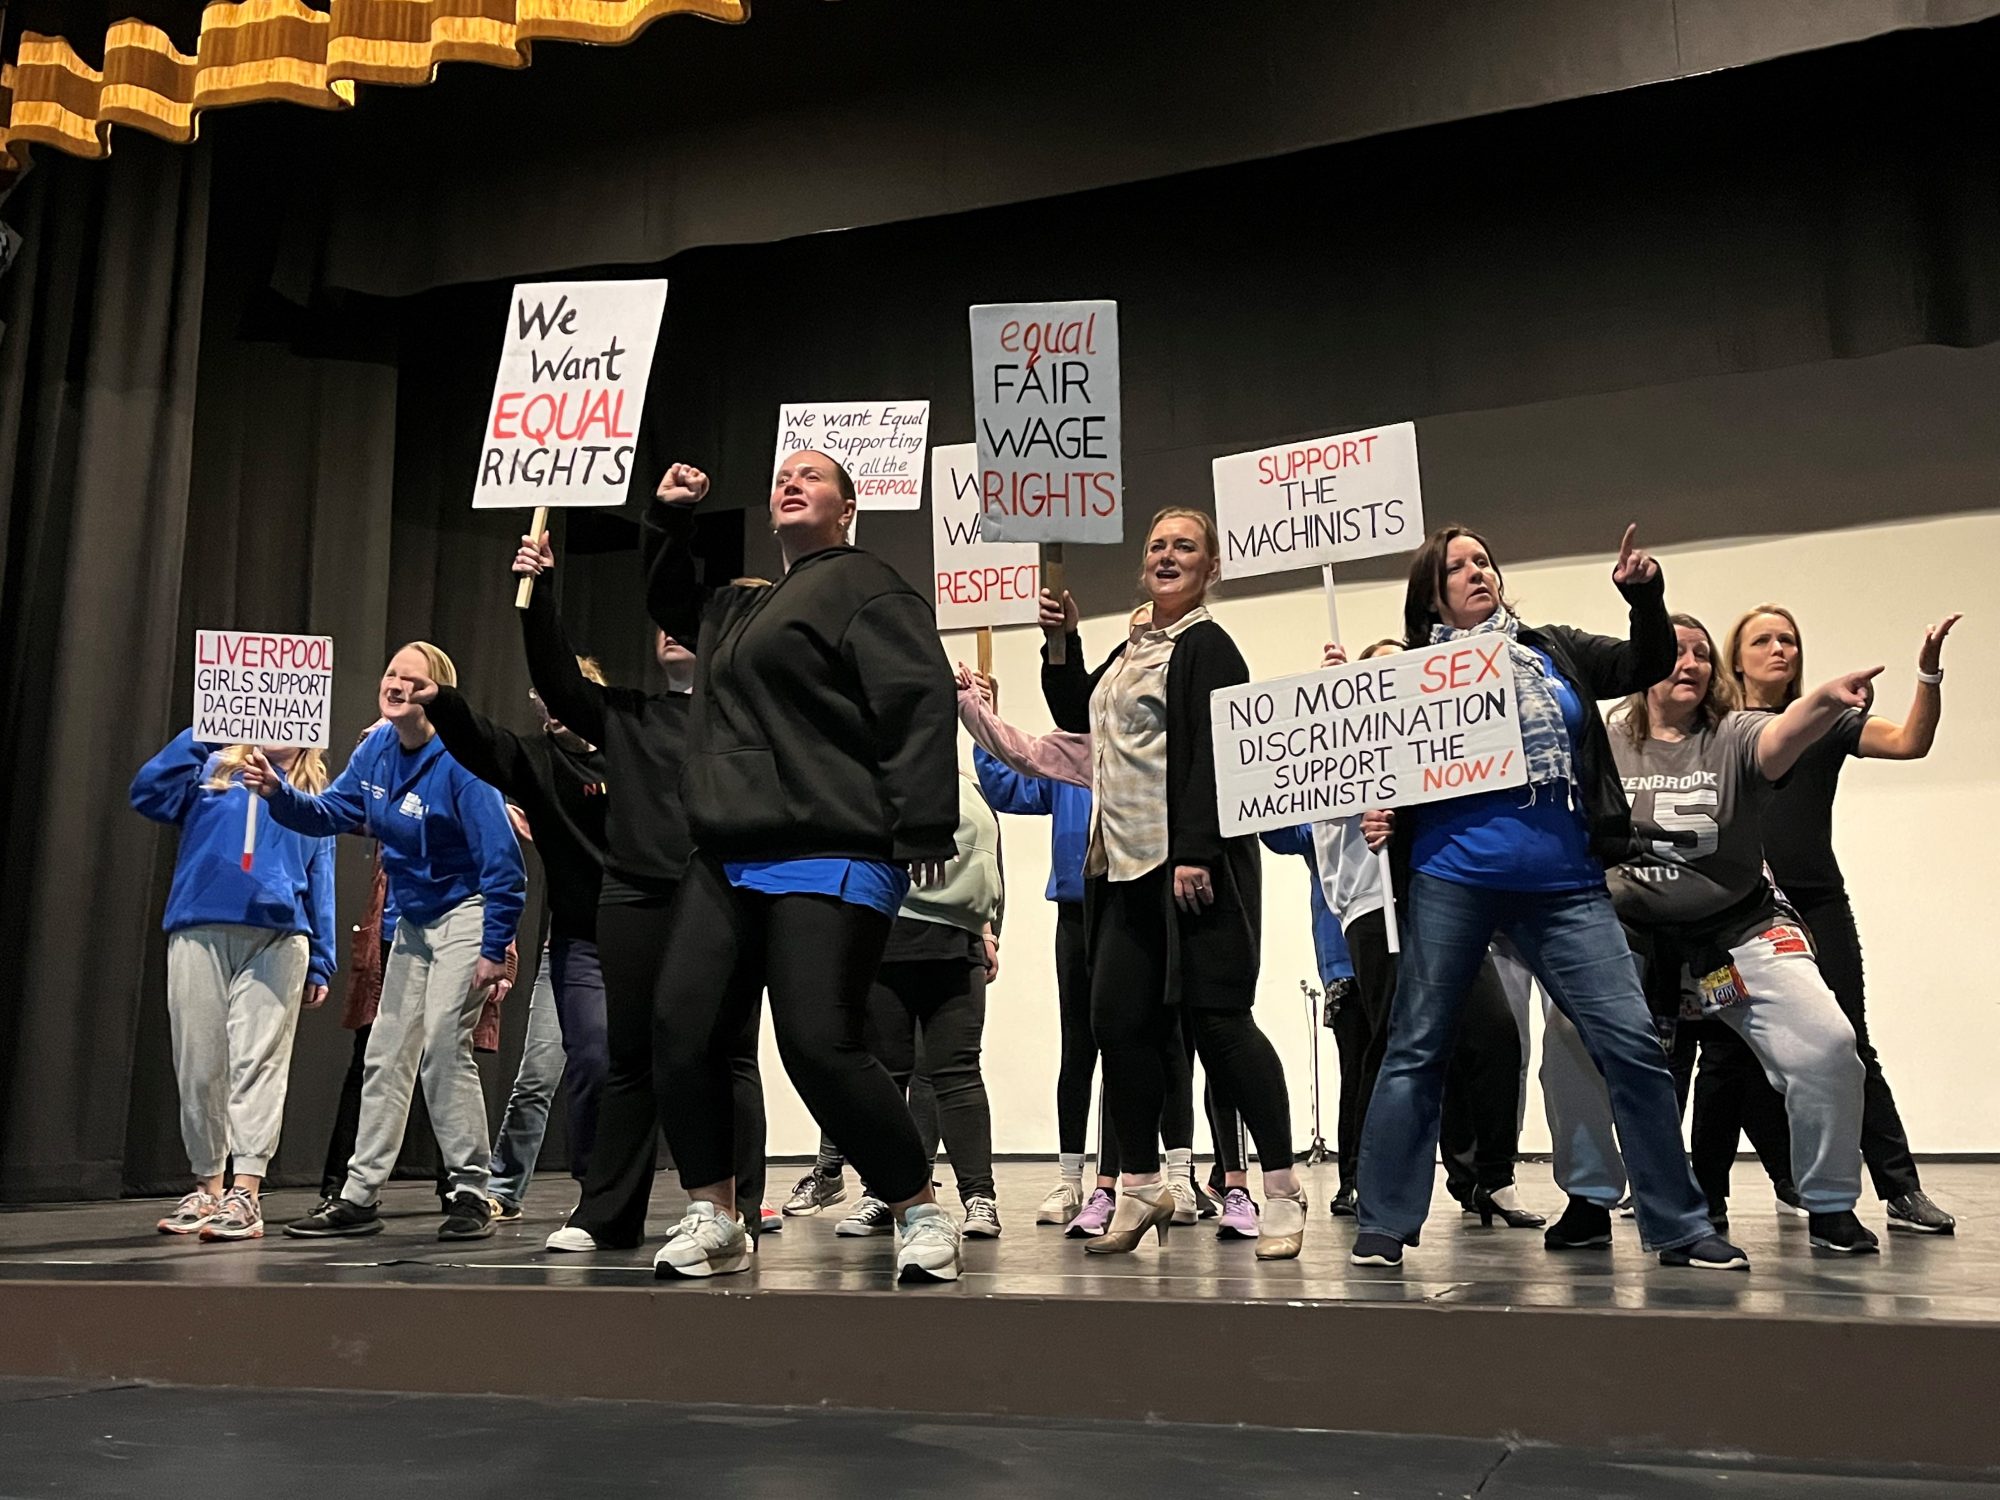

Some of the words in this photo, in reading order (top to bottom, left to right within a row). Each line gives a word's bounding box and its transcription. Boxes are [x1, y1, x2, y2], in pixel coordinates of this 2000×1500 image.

[518, 295, 579, 340] We
[532, 336, 625, 384] Want
[1000, 312, 1096, 370] equal
[994, 361, 1091, 404] FAIR
[493, 388, 633, 446] EQUAL
[786, 409, 816, 427] We
[823, 409, 872, 427] want
[880, 407, 926, 432] Equal
[983, 416, 1108, 459] WAGE
[823, 430, 923, 456] Supporting
[1258, 435, 1378, 485] SUPPORT
[481, 445, 634, 487] RIGHTS
[859, 457, 880, 475] all
[883, 456, 908, 473] the
[853, 479, 918, 496] VERPOOL
[983, 470, 1116, 517] RIGHTS
[1279, 475, 1337, 511] THE
[1227, 499, 1405, 561] MACHINISTS
[938, 565, 1039, 605] RESPECT
[199, 634, 331, 671] LIVERPOOL
[198, 669, 254, 692] GIRLS
[258, 672, 331, 697] SUPPORT
[1229, 693, 1274, 730] NO
[1295, 668, 1397, 718] MORE
[1420, 641, 1504, 694] SEX
[204, 693, 323, 719] DAGENHAM
[1239, 688, 1506, 766] DISCRIMINATION
[198, 717, 321, 742] MACHINISTS
[1273, 745, 1392, 789] SUPPORT
[1408, 733, 1466, 765] THE
[1620, 770, 1717, 790] EENBROOK
[1238, 774, 1397, 821] MACHINISTS
